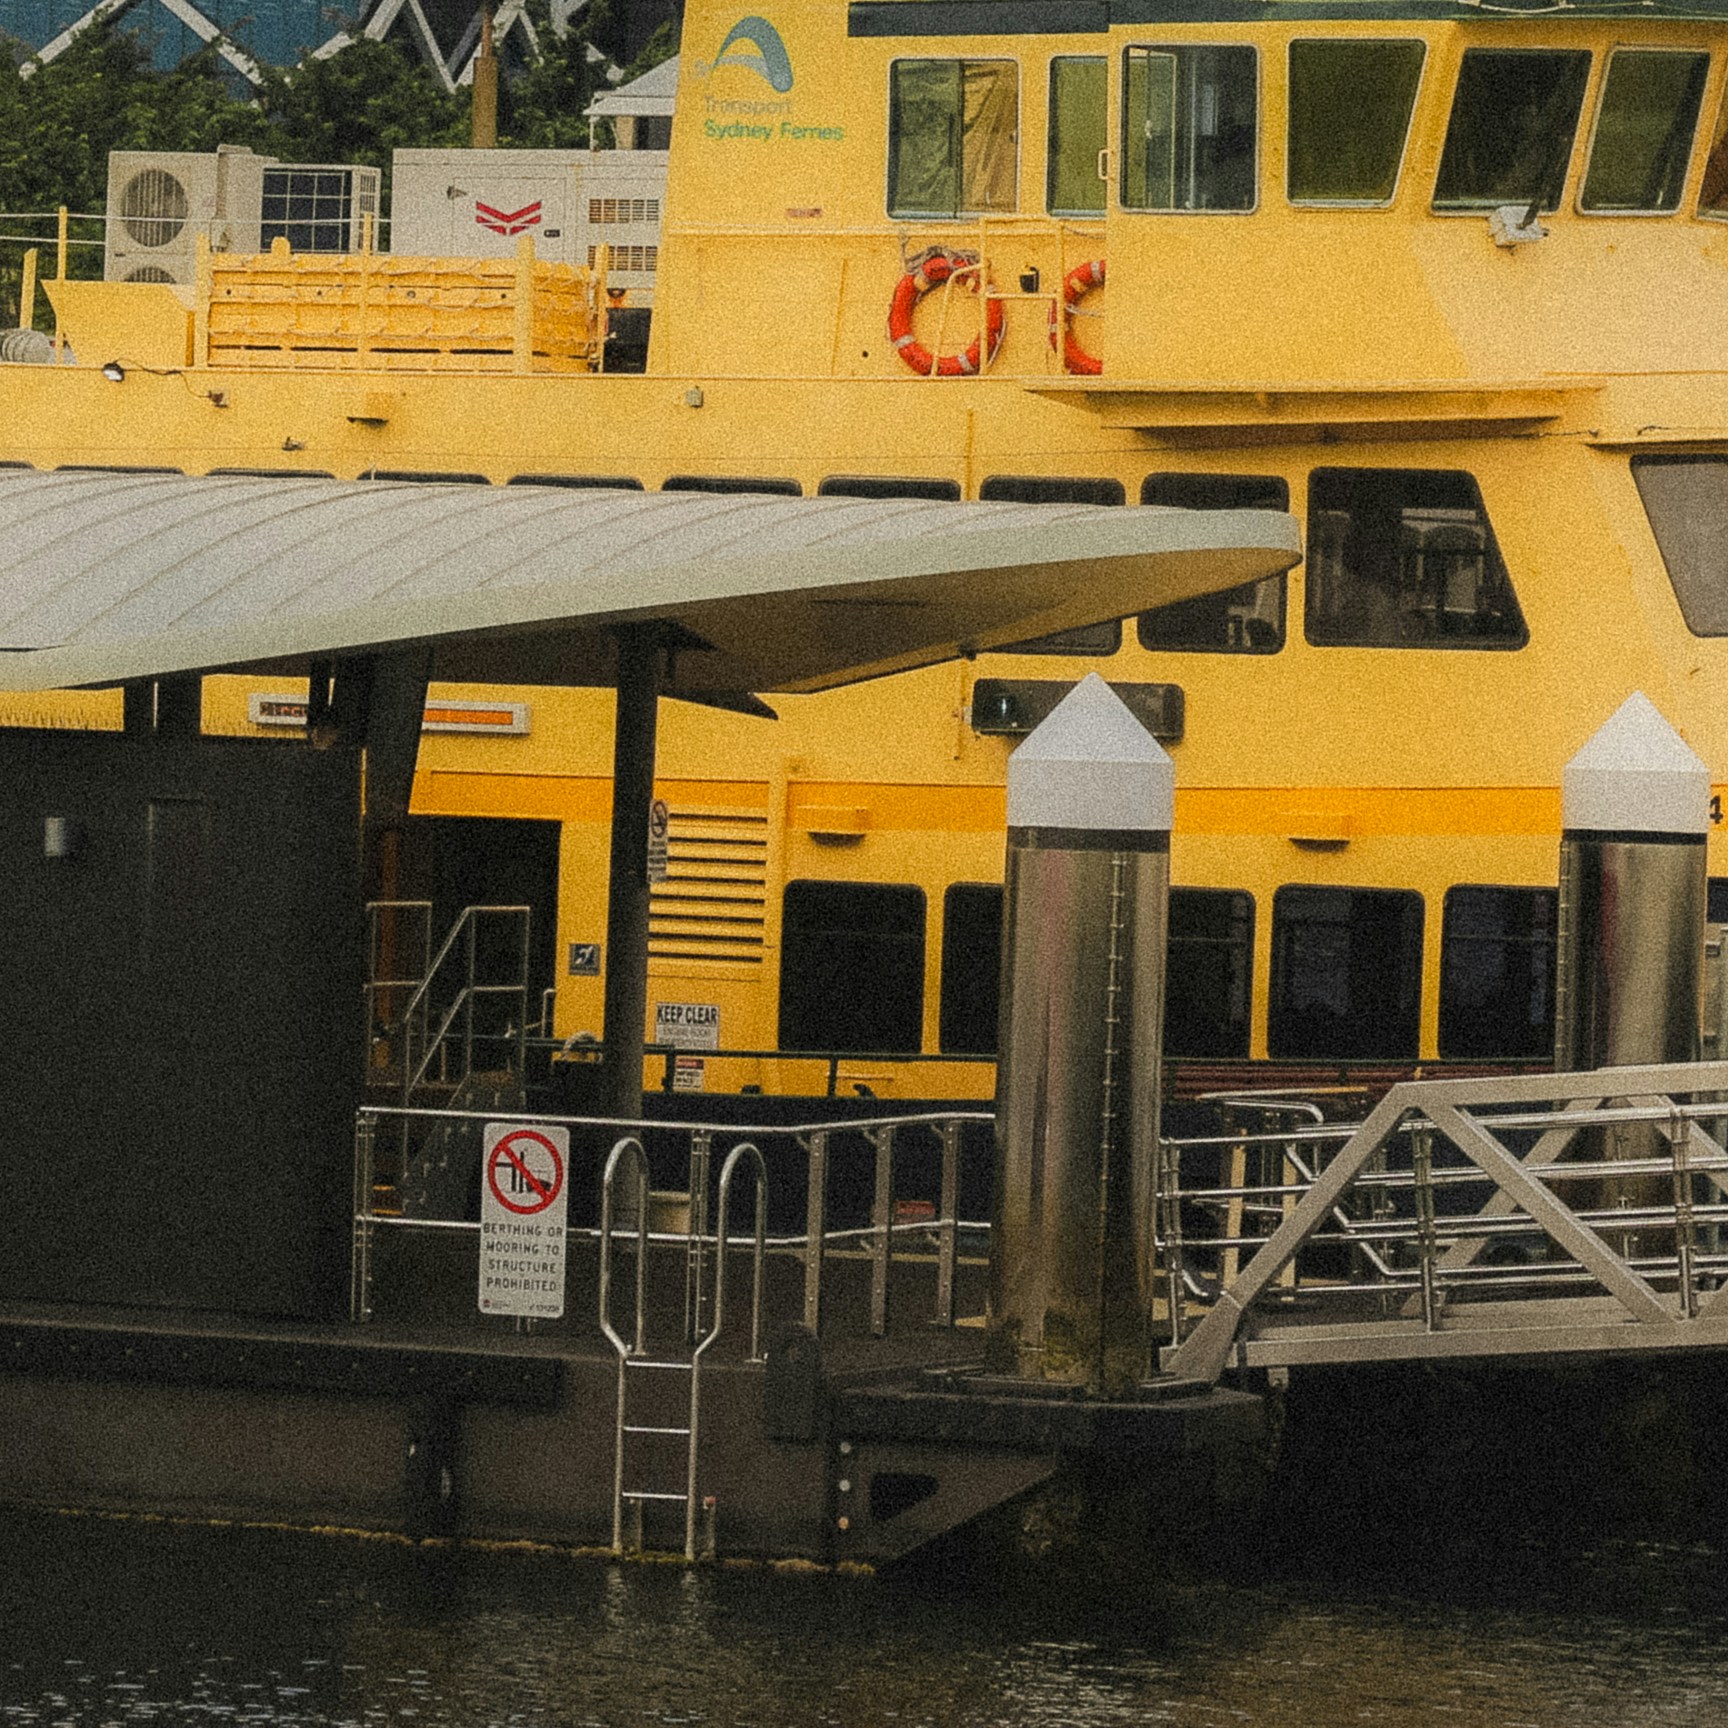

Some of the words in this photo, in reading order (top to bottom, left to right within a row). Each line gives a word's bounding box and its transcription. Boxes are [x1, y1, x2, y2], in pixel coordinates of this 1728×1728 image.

[704, 120, 772, 142] Sydney
[780, 122, 845, 141] Ferries
[658, 1005, 683, 1024] KEEP
[685, 1007, 717, 1025] CLEAR
[483, 1222, 542, 1236] BERTHING
[548, 1226, 563, 1238] OR
[486, 1241, 539, 1255] MOORING
[545, 1244, 560, 1255] TO
[488, 1259, 556, 1274] STRUCTURE
[486, 1277, 557, 1292] PROHIBITED
